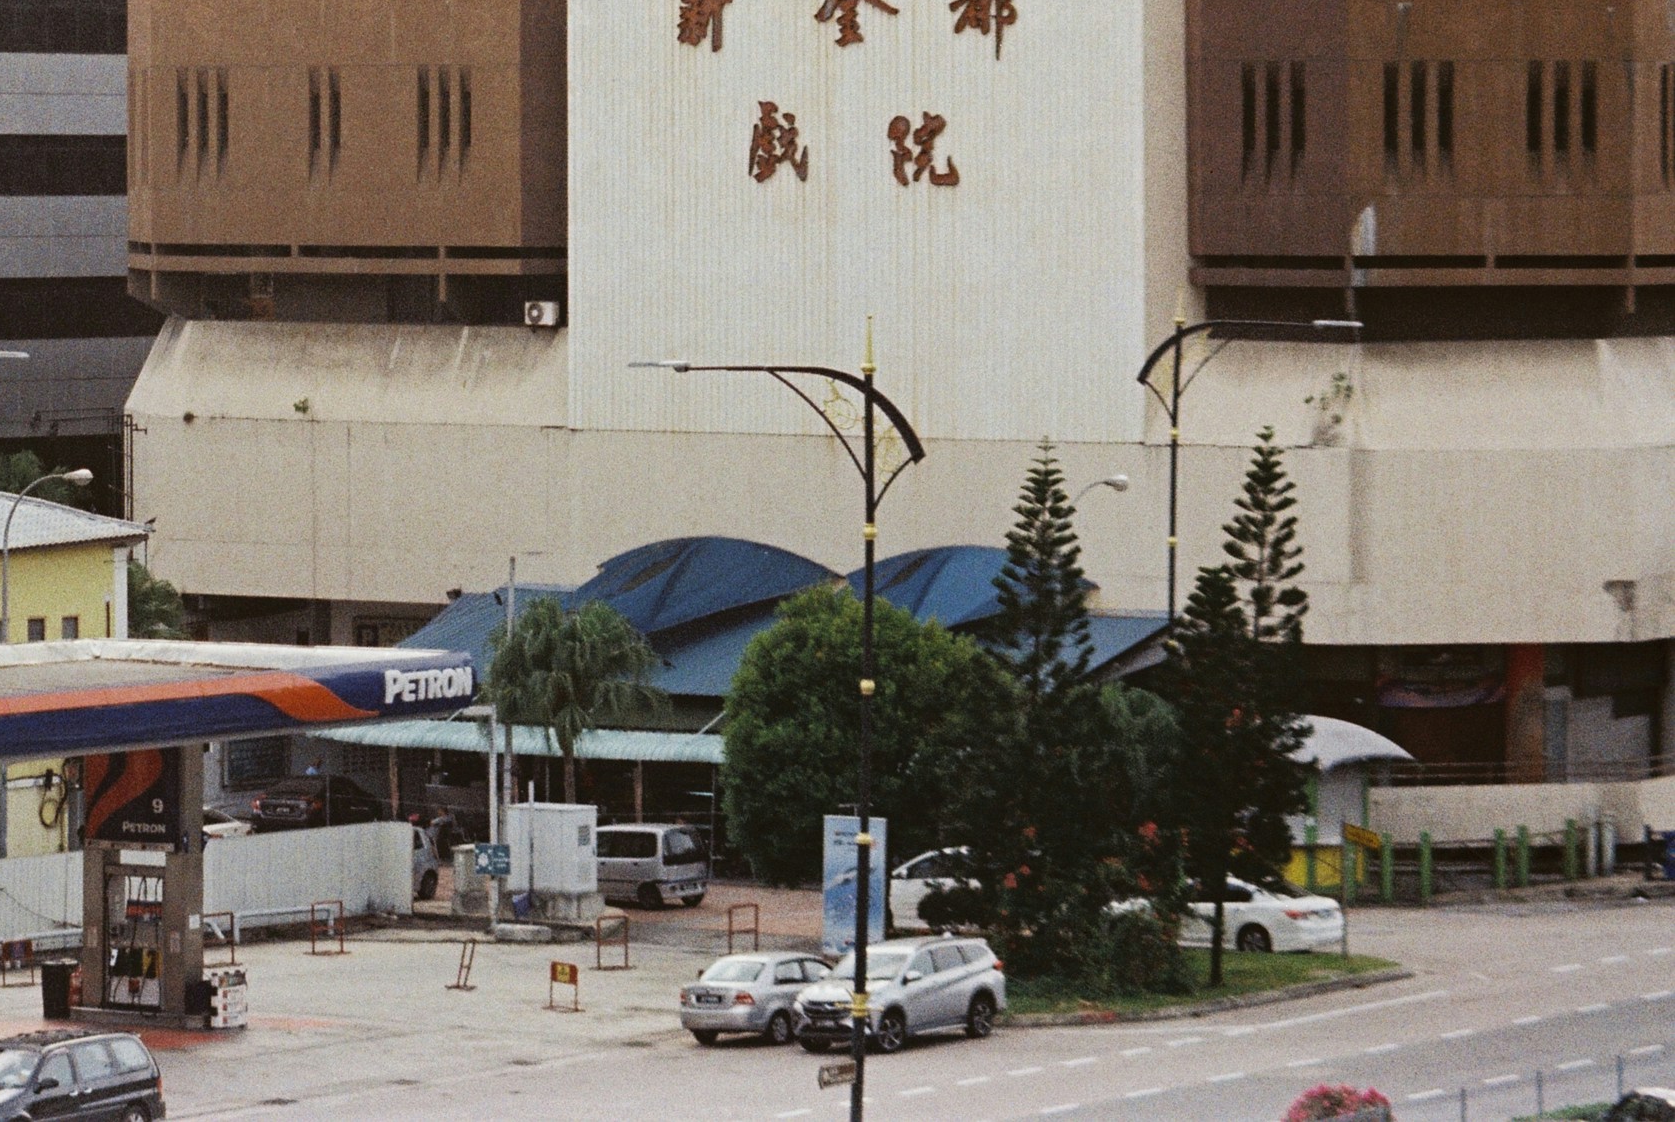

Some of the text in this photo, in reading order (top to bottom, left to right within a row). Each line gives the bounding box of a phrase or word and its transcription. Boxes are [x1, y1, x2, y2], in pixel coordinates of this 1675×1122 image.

[385, 666, 472, 704] PETRON
[152, 798, 164, 814] 9
[122, 821, 166, 833] PETRON
